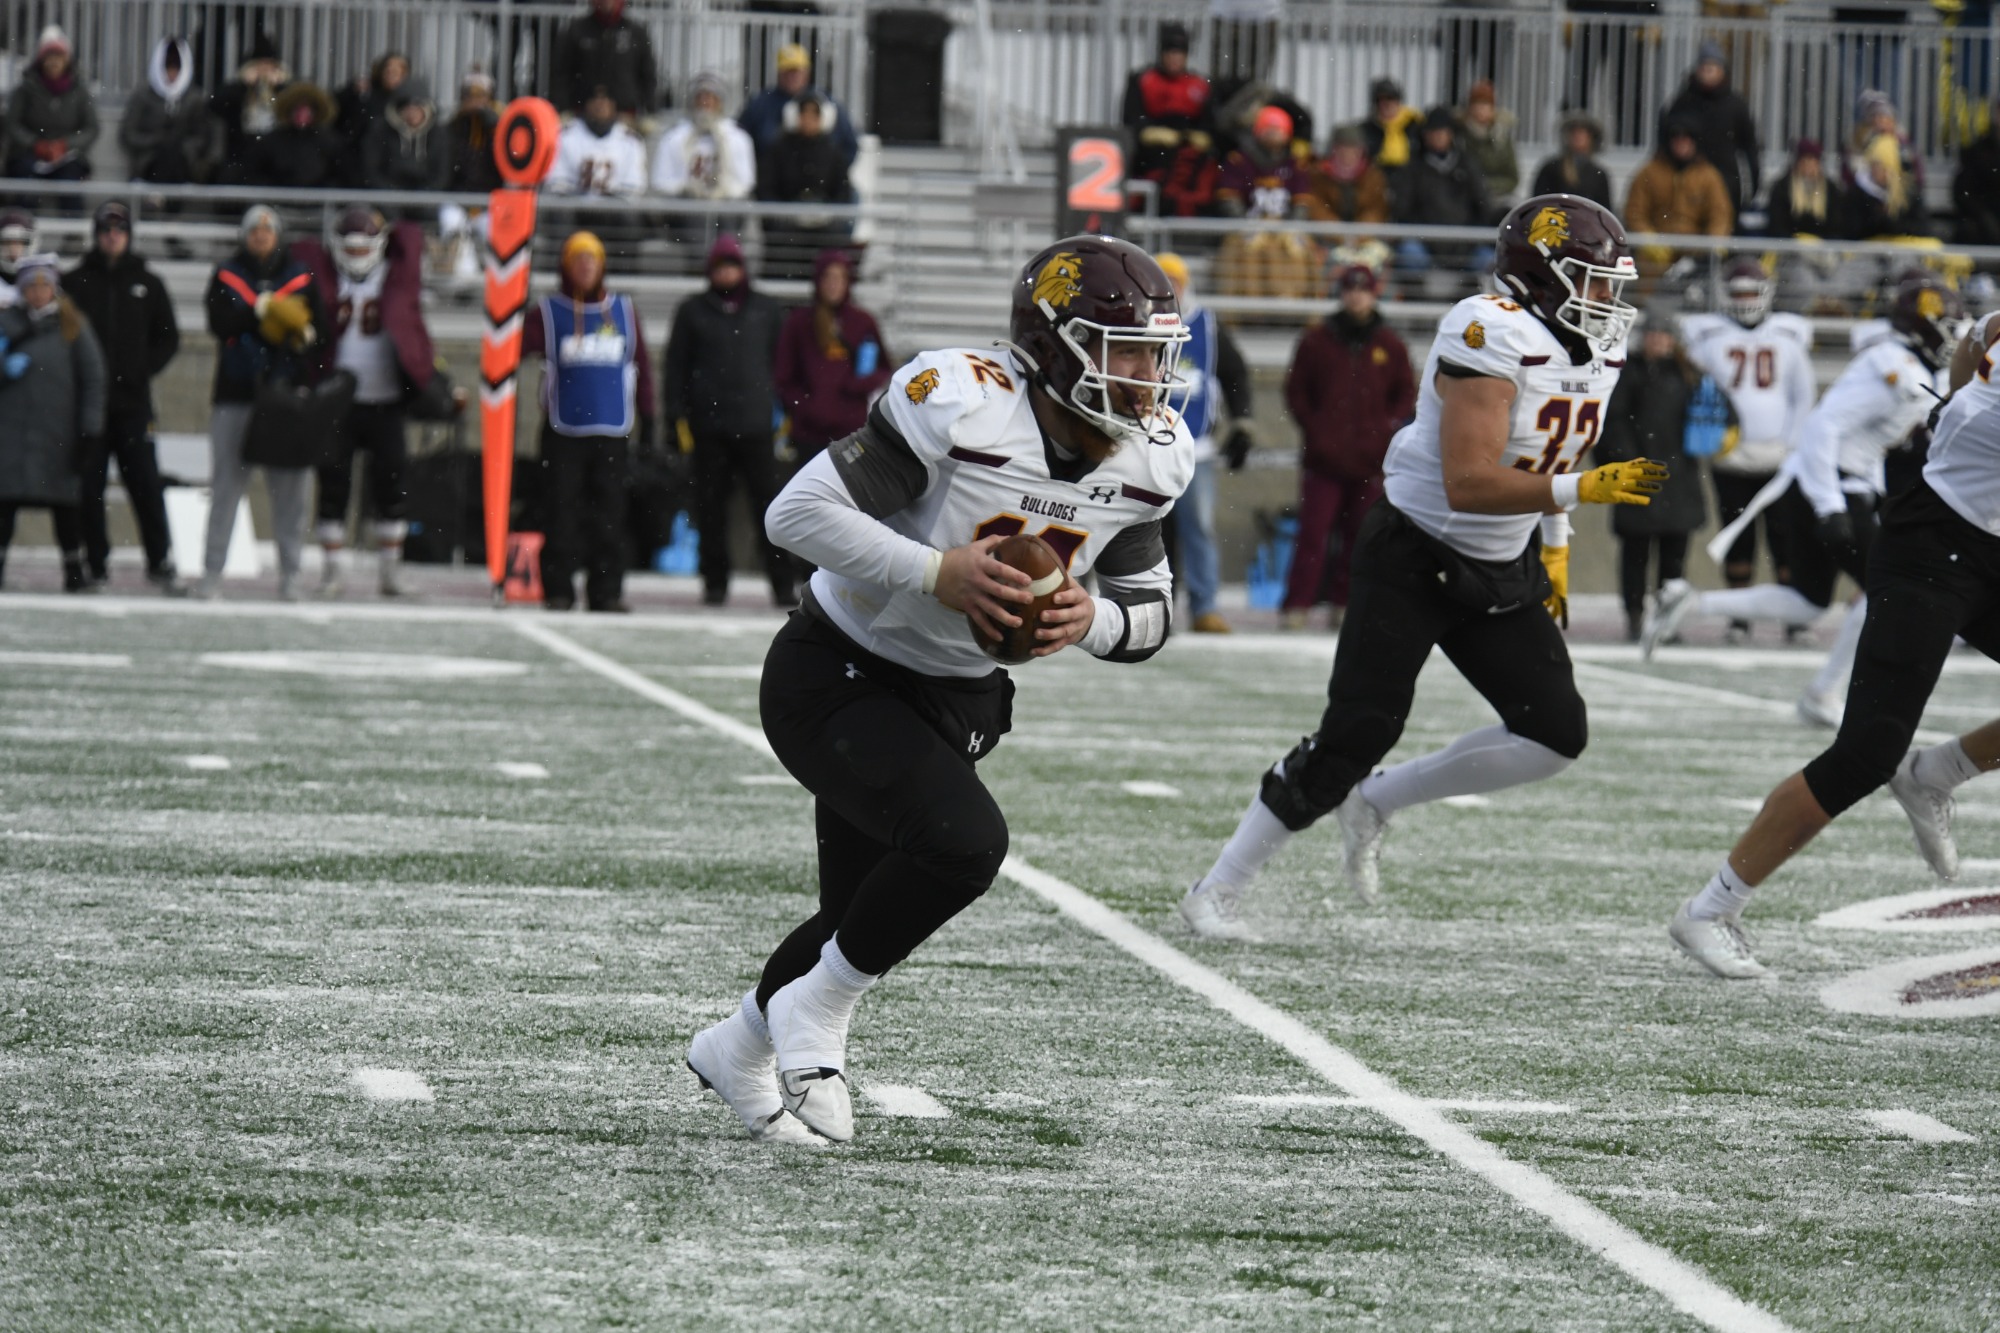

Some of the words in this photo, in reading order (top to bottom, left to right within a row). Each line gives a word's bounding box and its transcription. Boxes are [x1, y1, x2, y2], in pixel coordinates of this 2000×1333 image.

[1067, 137, 1124, 212] 2
[1725, 346, 1776, 390] 70
[1513, 394, 1601, 475] 33
[1020, 495, 1078, 522] BULLDOGS
